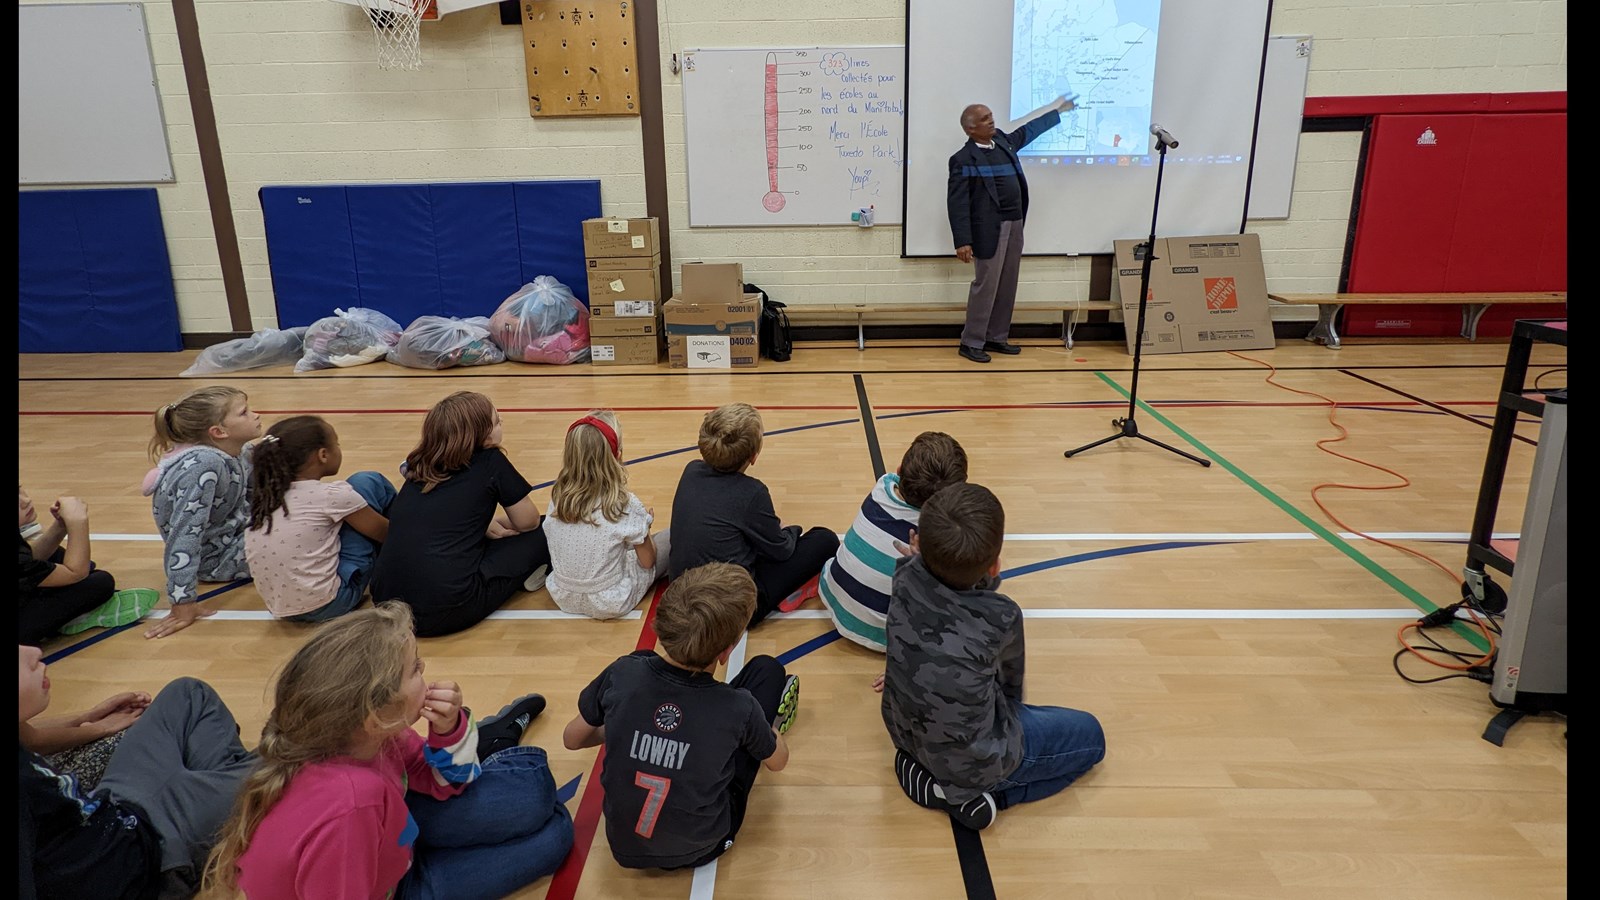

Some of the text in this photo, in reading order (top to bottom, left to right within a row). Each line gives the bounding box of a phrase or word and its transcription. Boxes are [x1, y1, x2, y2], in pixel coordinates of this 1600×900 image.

[821, 104, 838, 114] nord
[829, 121, 850, 142] Merci
[1207, 277, 1228, 302] HOME
[1212, 281, 1236, 309] DEPOT
[658, 705, 681, 718] TORONTO
[656, 718, 678, 731] RAPTORS
[629, 730, 691, 770] LOWRY
[634, 770, 672, 839] 7
